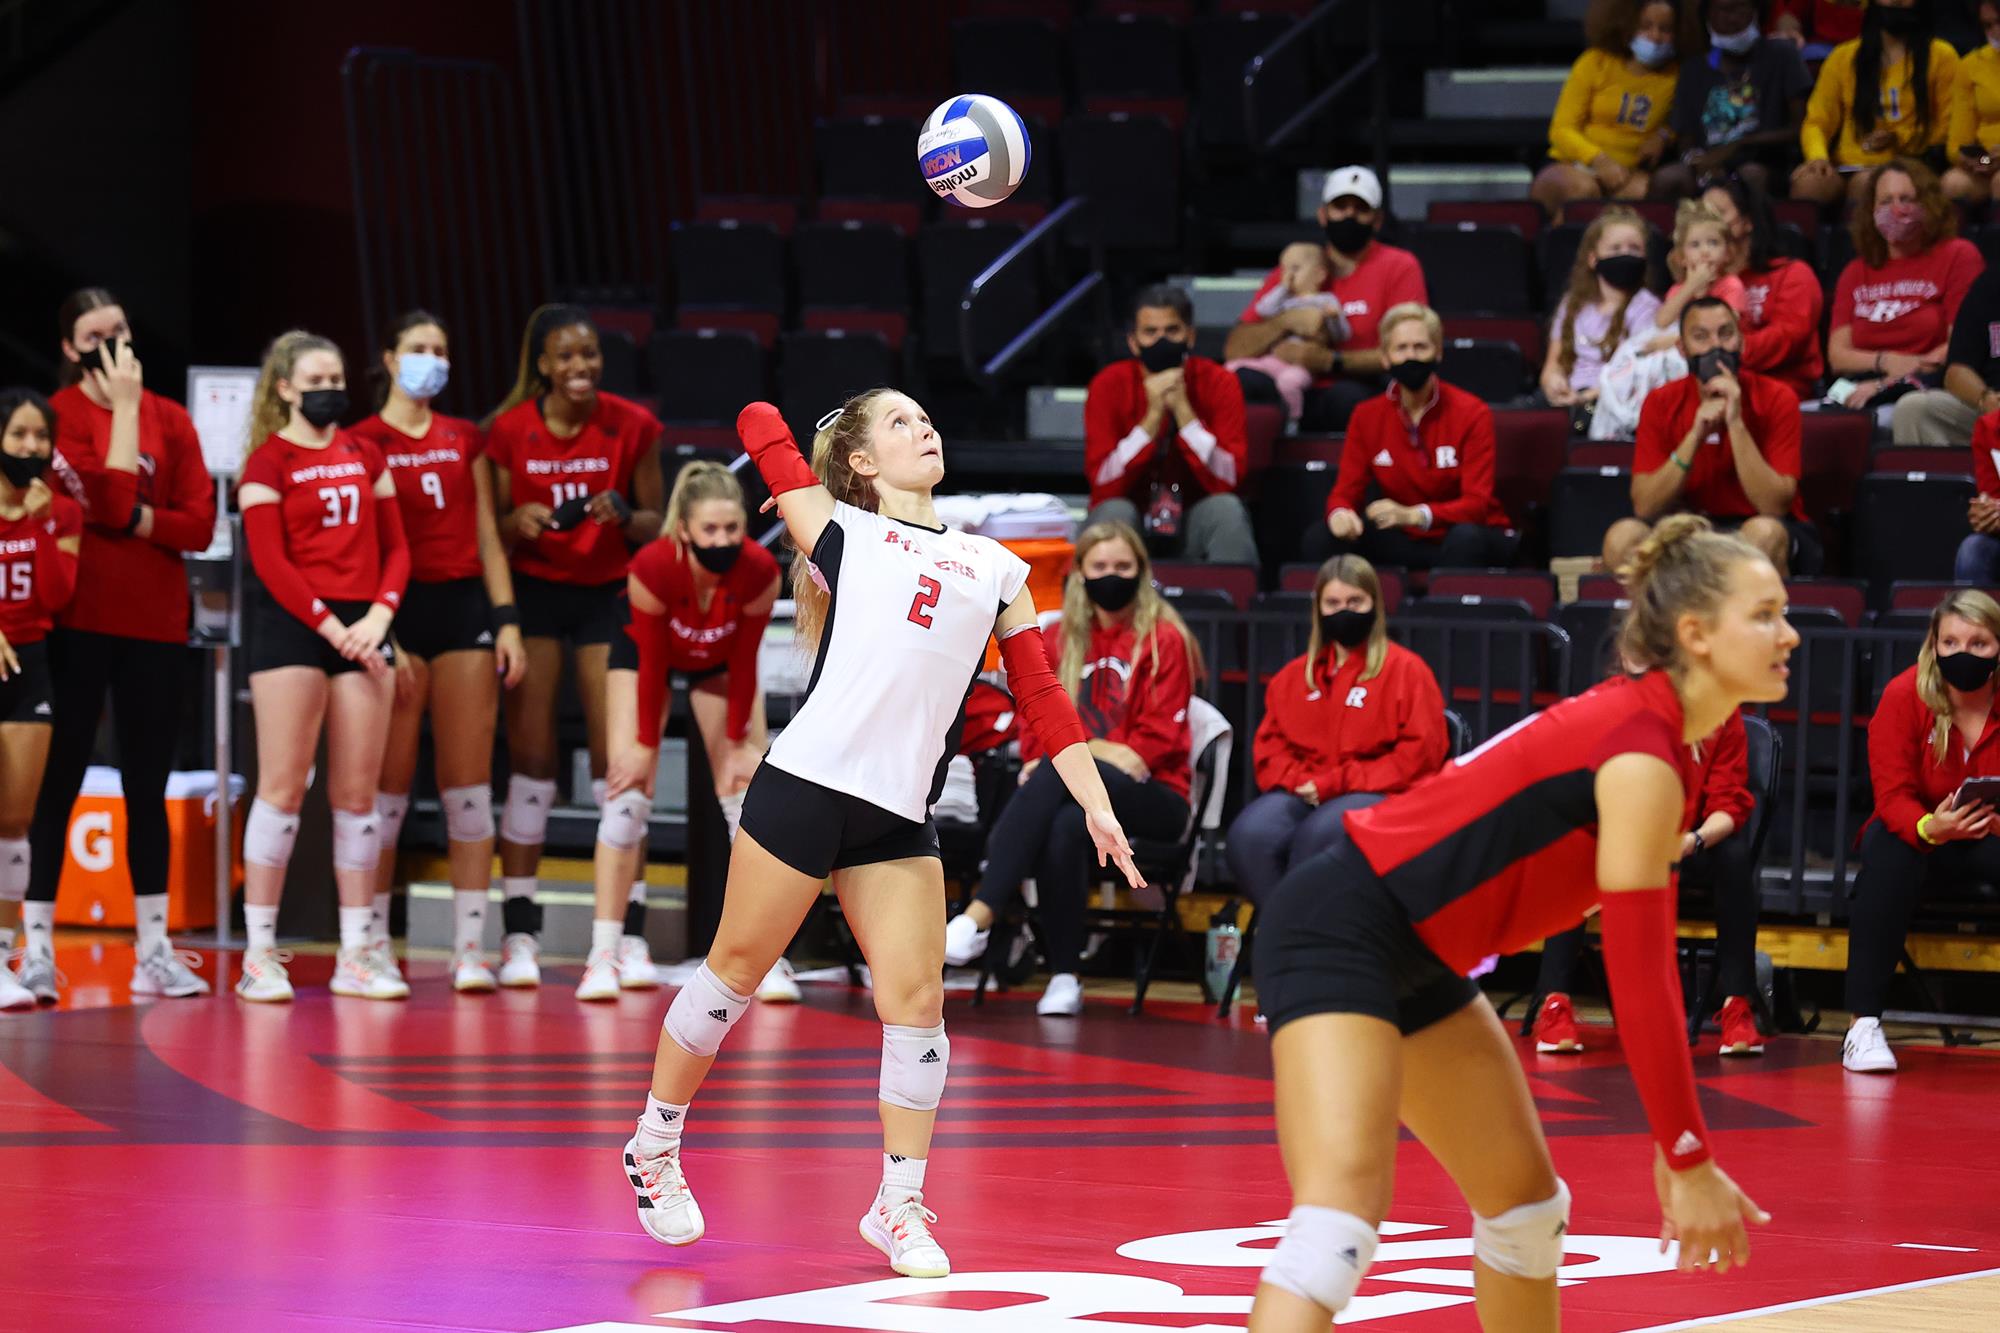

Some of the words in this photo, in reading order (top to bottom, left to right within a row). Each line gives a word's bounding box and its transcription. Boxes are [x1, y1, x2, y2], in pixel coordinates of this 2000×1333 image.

[1616, 91, 1651, 132] 12
[924, 149, 962, 176] NCAA
[930, 164, 978, 192] molten
[1436, 445, 1459, 469] R
[318, 484, 360, 528] 37
[421, 471, 446, 510] 9
[0, 561, 33, 601] 15
[907, 573, 942, 630] 2
[1345, 686, 1368, 709] R
[70, 811, 114, 872] G
